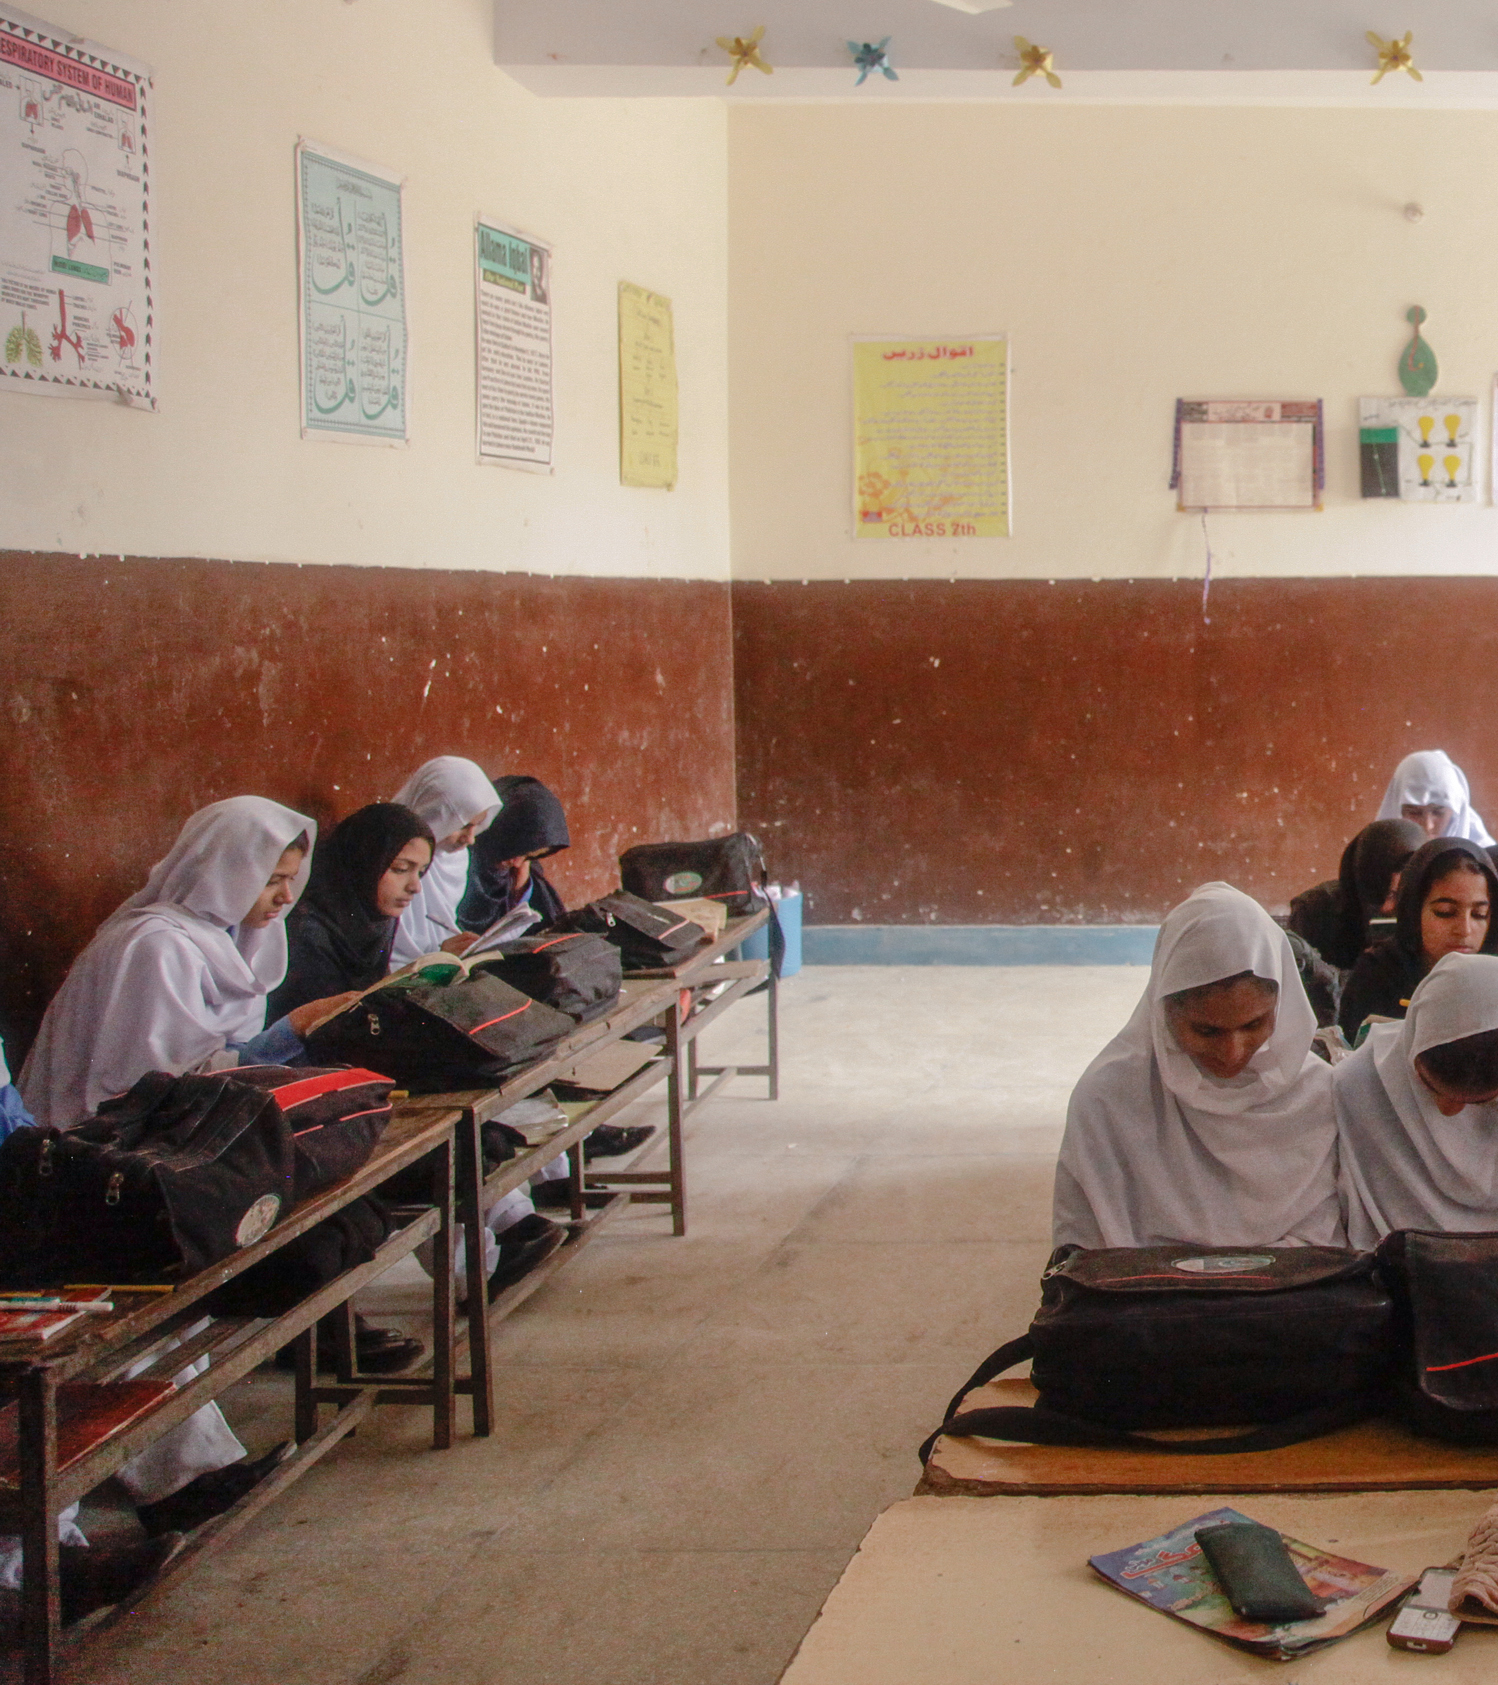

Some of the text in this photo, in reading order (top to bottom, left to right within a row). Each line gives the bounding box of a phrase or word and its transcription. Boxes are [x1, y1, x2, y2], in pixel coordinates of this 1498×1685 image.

[0, 37, 54, 73] ESPIRATORY
[57, 60, 90, 87] SYSTEM
[91, 74, 102, 92] OF
[104, 78, 133, 104] HUMAN
[481, 229, 529, 275] Allama Iqbal
[888, 522, 947, 538] CLASS
